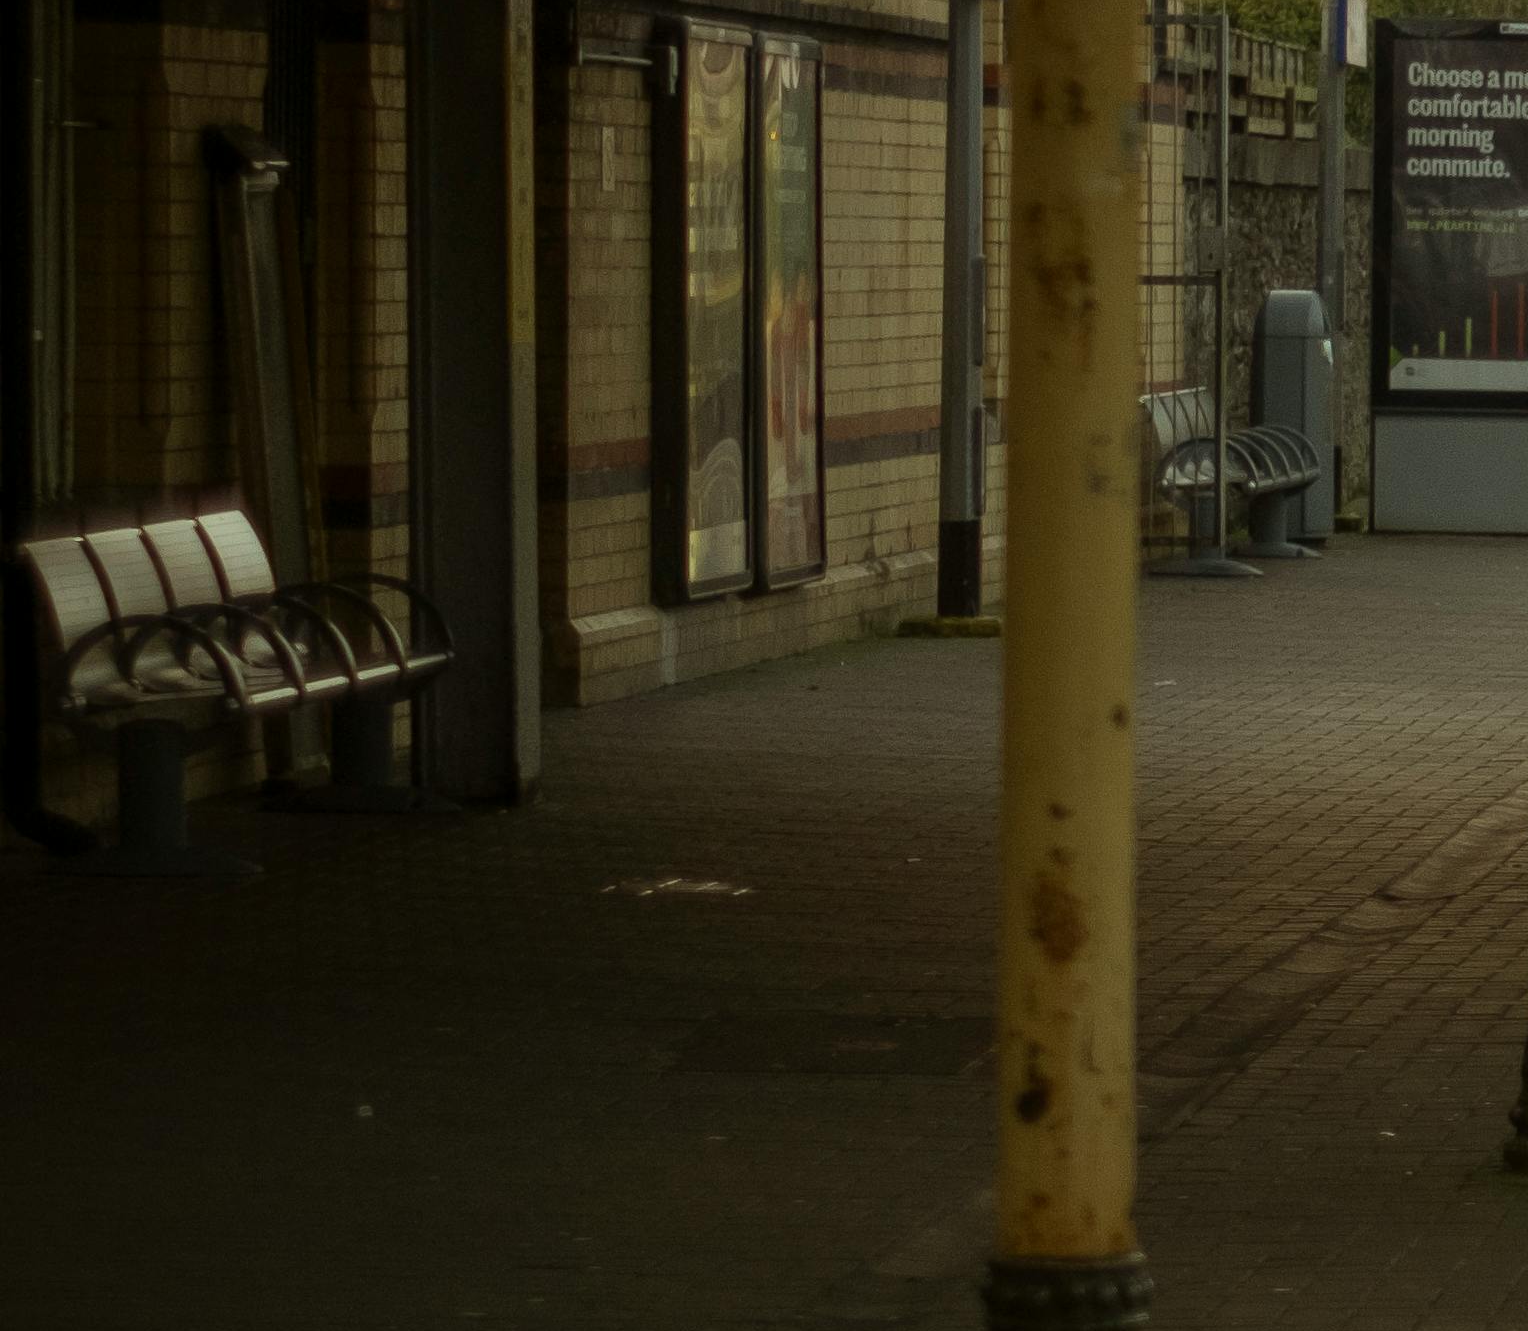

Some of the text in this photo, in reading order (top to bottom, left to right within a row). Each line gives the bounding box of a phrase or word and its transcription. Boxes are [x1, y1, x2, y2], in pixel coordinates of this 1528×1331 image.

[1408, 62, 1484, 89] Choose
[1487, 69, 1499, 89] a
[1407, 124, 1495, 153] morning
[1407, 156, 1511, 179] commute.
